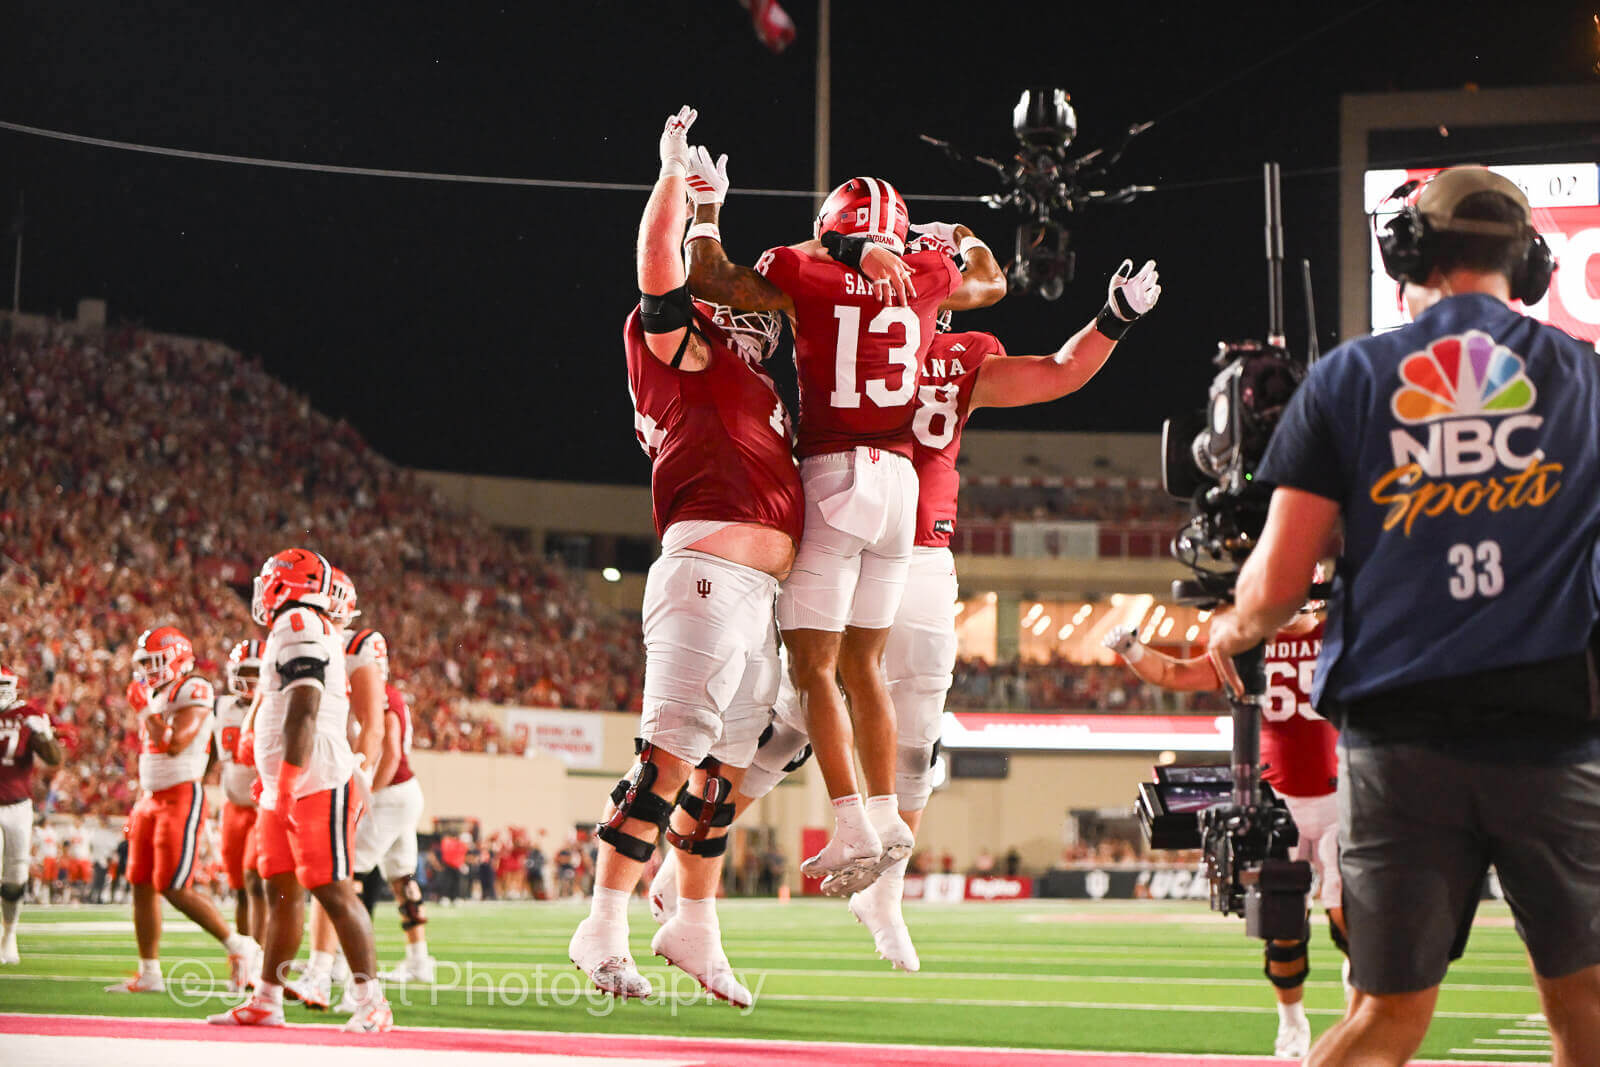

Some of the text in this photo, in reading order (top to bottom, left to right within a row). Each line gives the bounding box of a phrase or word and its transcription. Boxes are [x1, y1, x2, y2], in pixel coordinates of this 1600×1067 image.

[830, 305, 921, 408] 13
[1389, 414, 1545, 484] NBC
[1370, 457, 1563, 537] Sports
[1447, 540, 1505, 600] 33
[1262, 660, 1327, 722] 65
